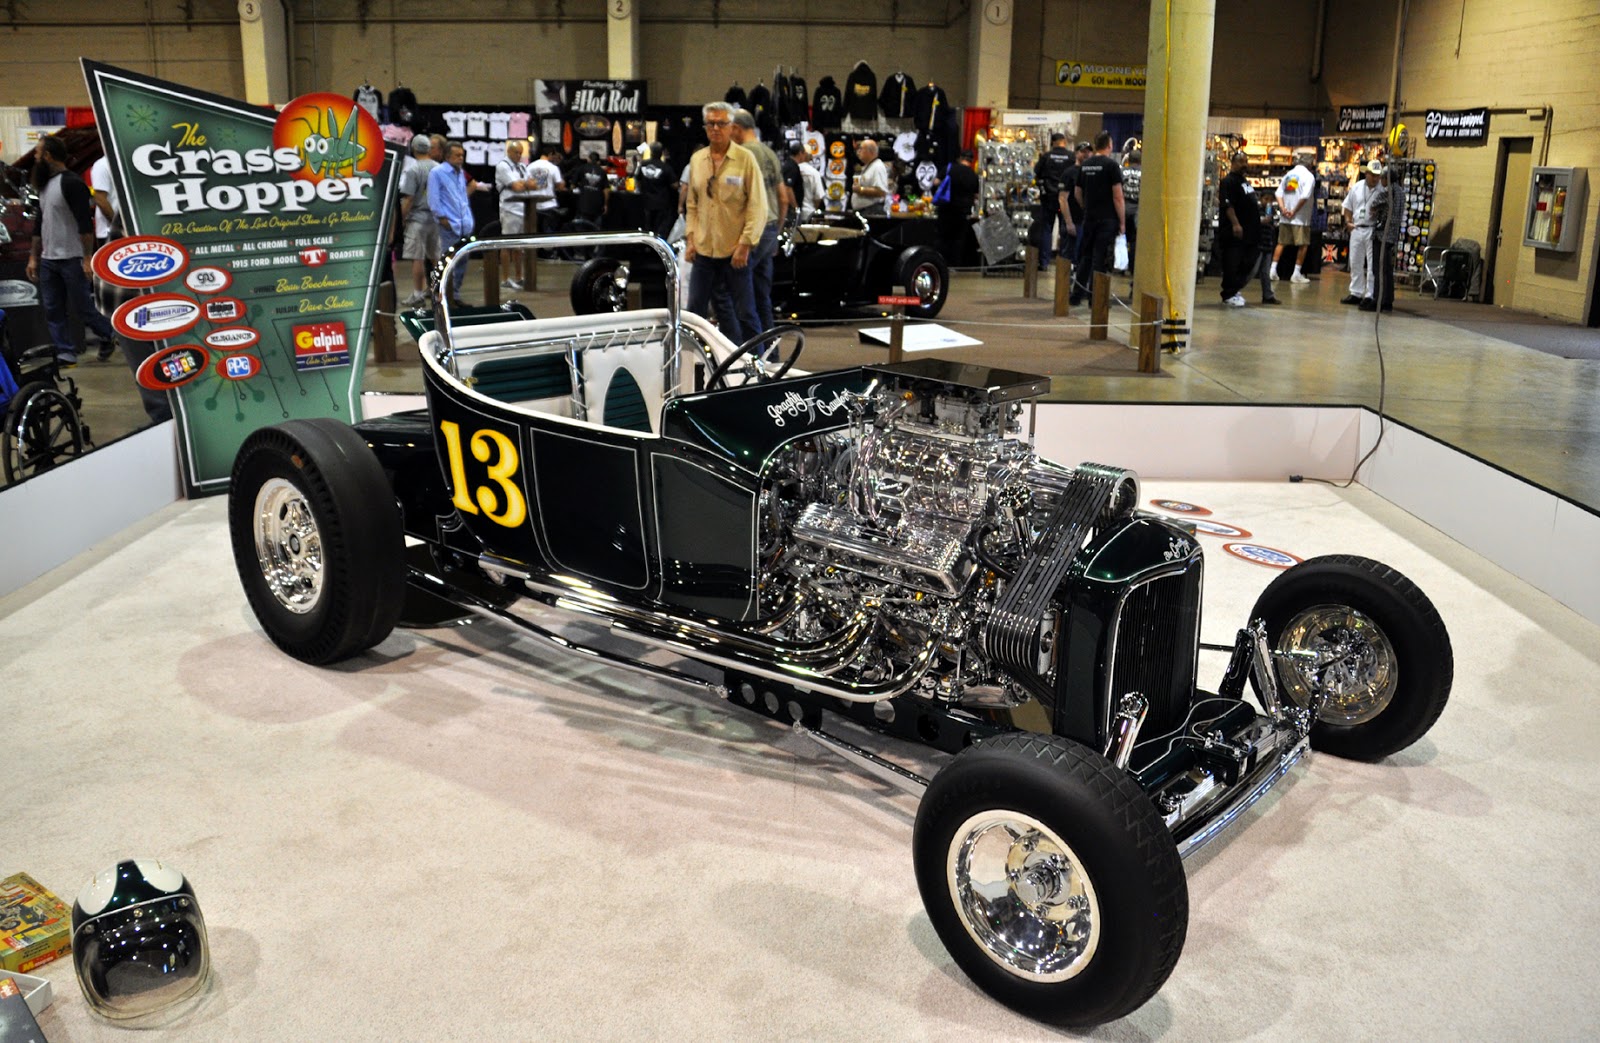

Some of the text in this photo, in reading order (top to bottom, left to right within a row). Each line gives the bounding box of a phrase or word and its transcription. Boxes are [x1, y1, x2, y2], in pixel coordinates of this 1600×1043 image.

[246, 3, 253, 14] 3
[616, 0, 623, 12] 2
[1085, 65, 1147, 76] MOONEYE
[1091, 76, 1105, 85] GO!
[1107, 77, 1123, 86] with
[579, 89, 639, 113] Hot Rod
[171, 123, 206, 147] The
[132, 141, 302, 176] Grass
[151, 176, 373, 215] Hopper
[161, 224, 172, 235] A
[173, 222, 218, 235] Re-Creation
[219, 220, 232, 233] Of
[234, 219, 249, 230] The
[269, 214, 300, 231] Original
[300, 215, 320, 226] Show
[322, 216, 327, 225] &
[329, 213, 339, 227] Go
[340, 211, 374, 223] Roadster!
[113, 243, 176, 262] GALPIN
[195, 236, 333, 255] ALL METAL ALL CHROME FULL SCALE
[123, 256, 169, 275] Ford
[232, 258, 248, 269] 1915
[250, 257, 270, 267] FORD
[272, 255, 298, 266] MODEL
[329, 250, 364, 260] ROADSTER
[276, 278, 299, 293] Beau
[301, 275, 349, 291] Boeckmann
[275, 296, 355, 314] BUILDER Dave Shuten
[296, 330, 344, 352] Galpin
[162, 356, 196, 377] COLOR
[227, 357, 249, 373] PPG
[306, 354, 339, 365] Auto Sports
[440, 419, 527, 529] 13
